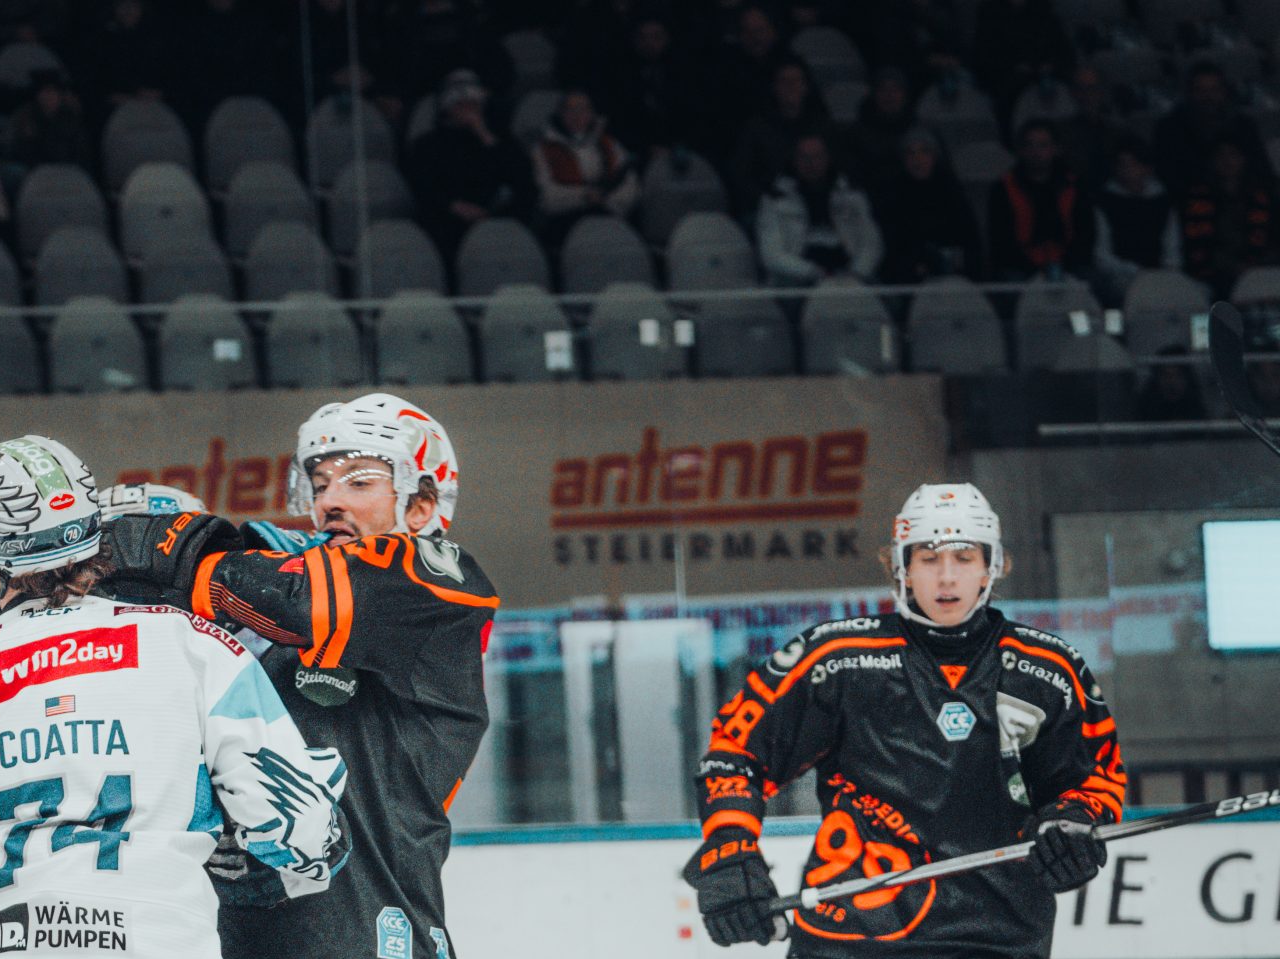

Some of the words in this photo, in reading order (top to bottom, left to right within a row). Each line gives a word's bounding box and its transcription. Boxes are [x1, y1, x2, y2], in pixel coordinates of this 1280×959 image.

[551, 427, 868, 506] antenne
[554, 529, 860, 565] STEIERMARK
[1, 639, 123, 685] win2day
[825, 654, 903, 675] GrazMobil
[295, 670, 356, 697] Steiermark
[34, 901, 125, 929] WÄRME
[34, 929, 127, 951] PUMPEN
[384, 935, 406, 951] 25
